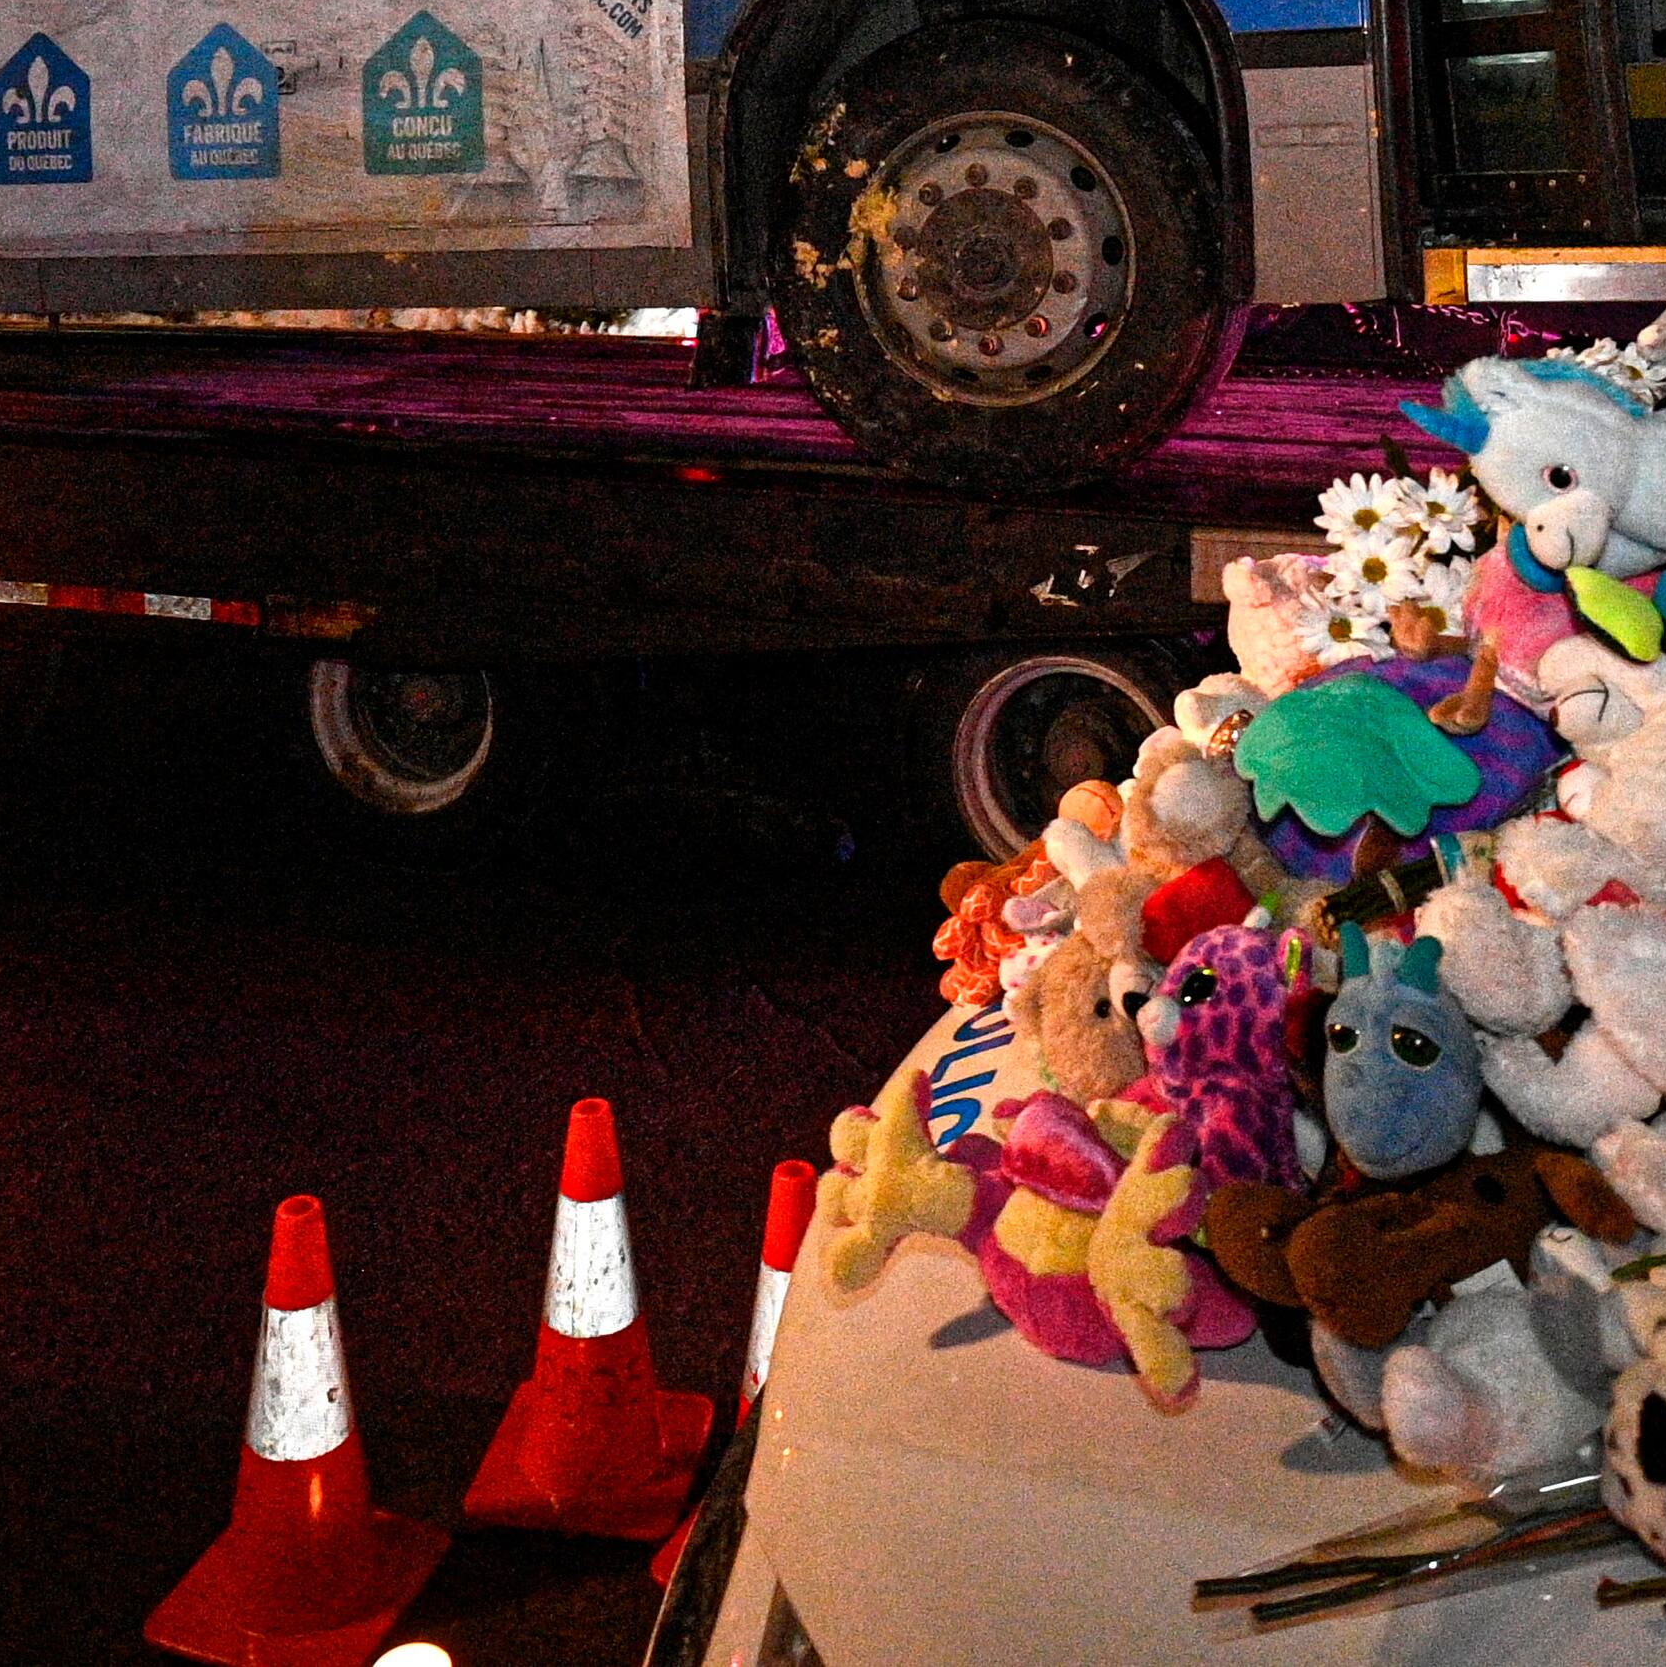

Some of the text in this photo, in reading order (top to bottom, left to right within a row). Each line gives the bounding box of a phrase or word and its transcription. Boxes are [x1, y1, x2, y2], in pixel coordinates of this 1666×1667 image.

[6, 129, 72, 150] PRODUIT
[190, 150, 208, 167] AU
[386, 143, 406, 161] AU
[8, 156, 25, 171] DU
[928, 1001, 1016, 1148] OLIC
